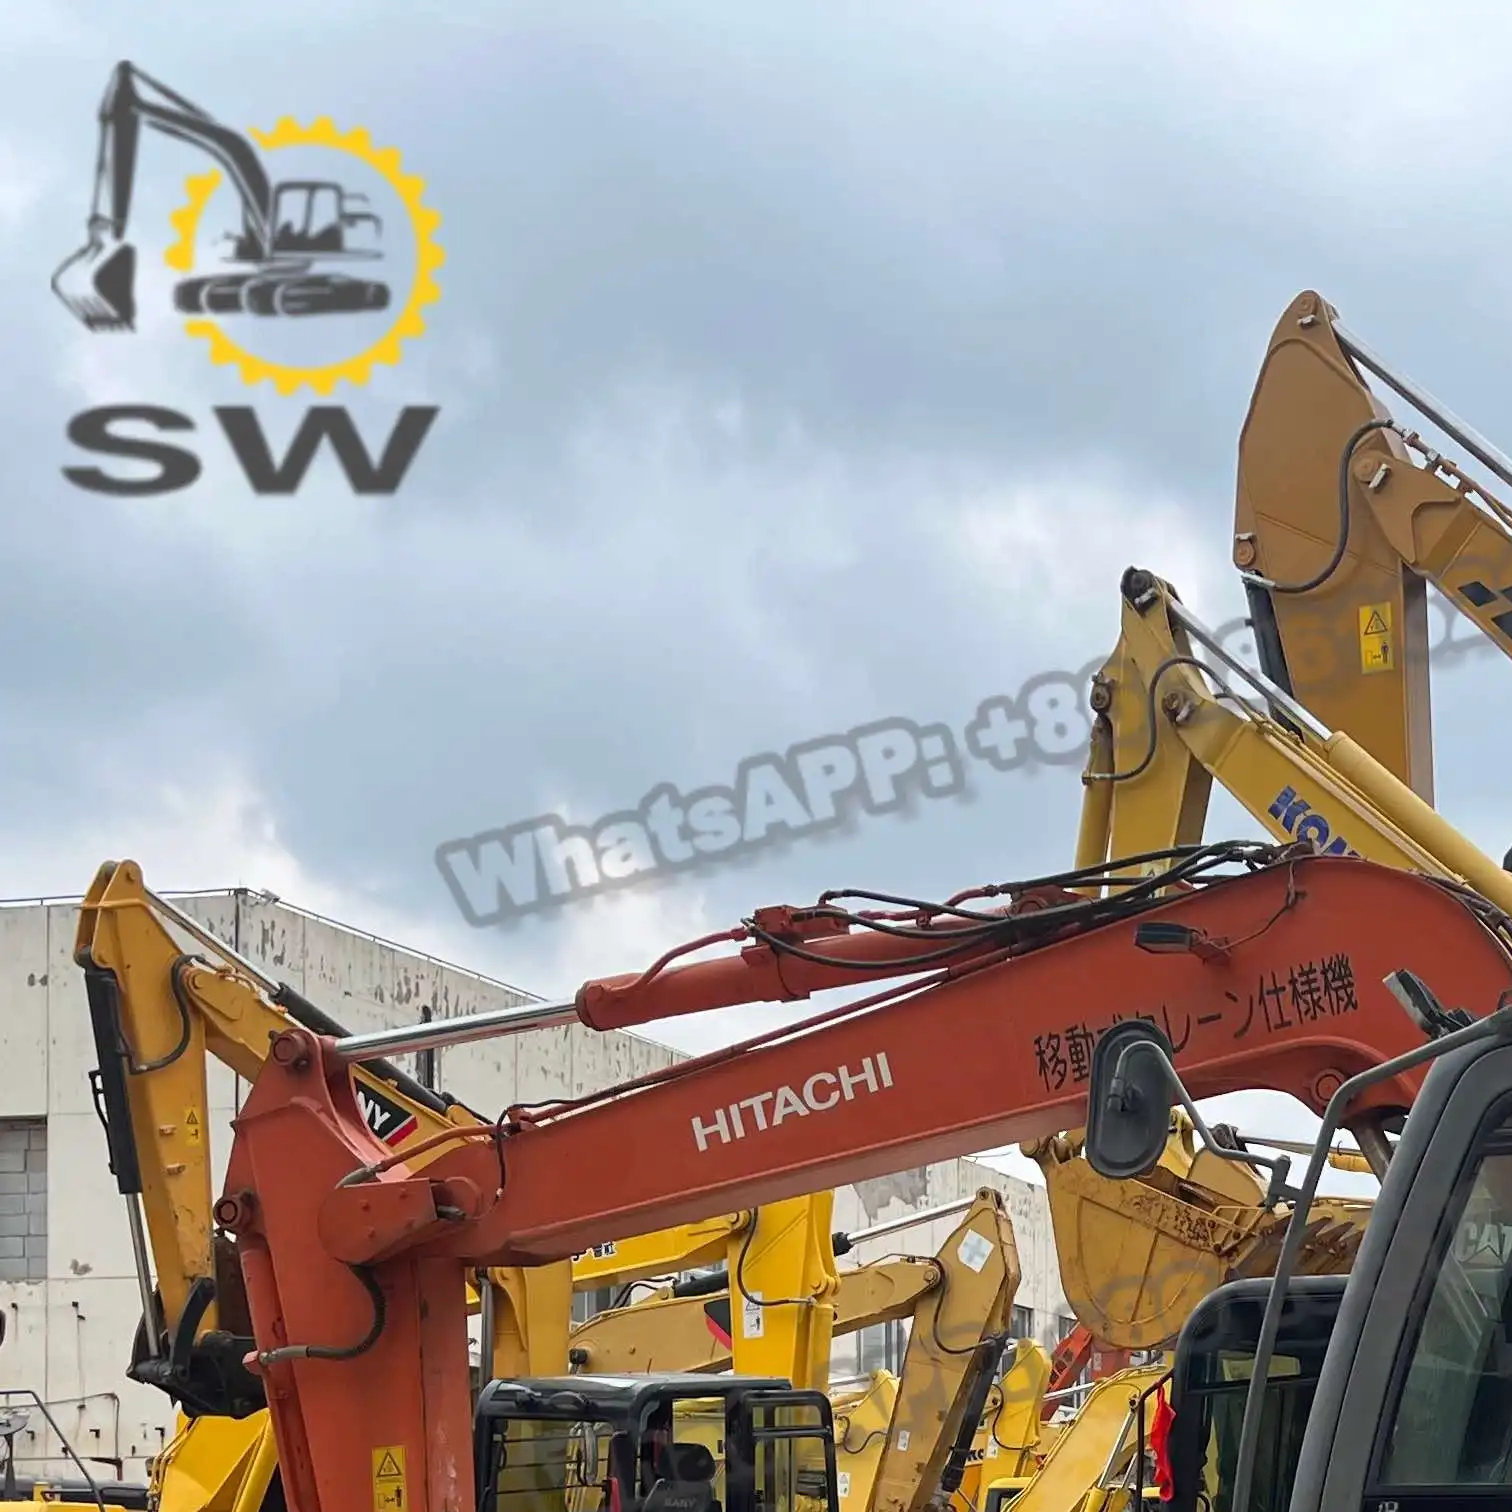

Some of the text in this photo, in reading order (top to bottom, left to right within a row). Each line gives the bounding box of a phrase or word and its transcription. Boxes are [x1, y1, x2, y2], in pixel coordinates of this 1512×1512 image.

[1268, 785, 1360, 856] KO
[1034, 953, 1358, 1093] 移動レーン仕様機
[691, 1052, 893, 1152] HITACHI
